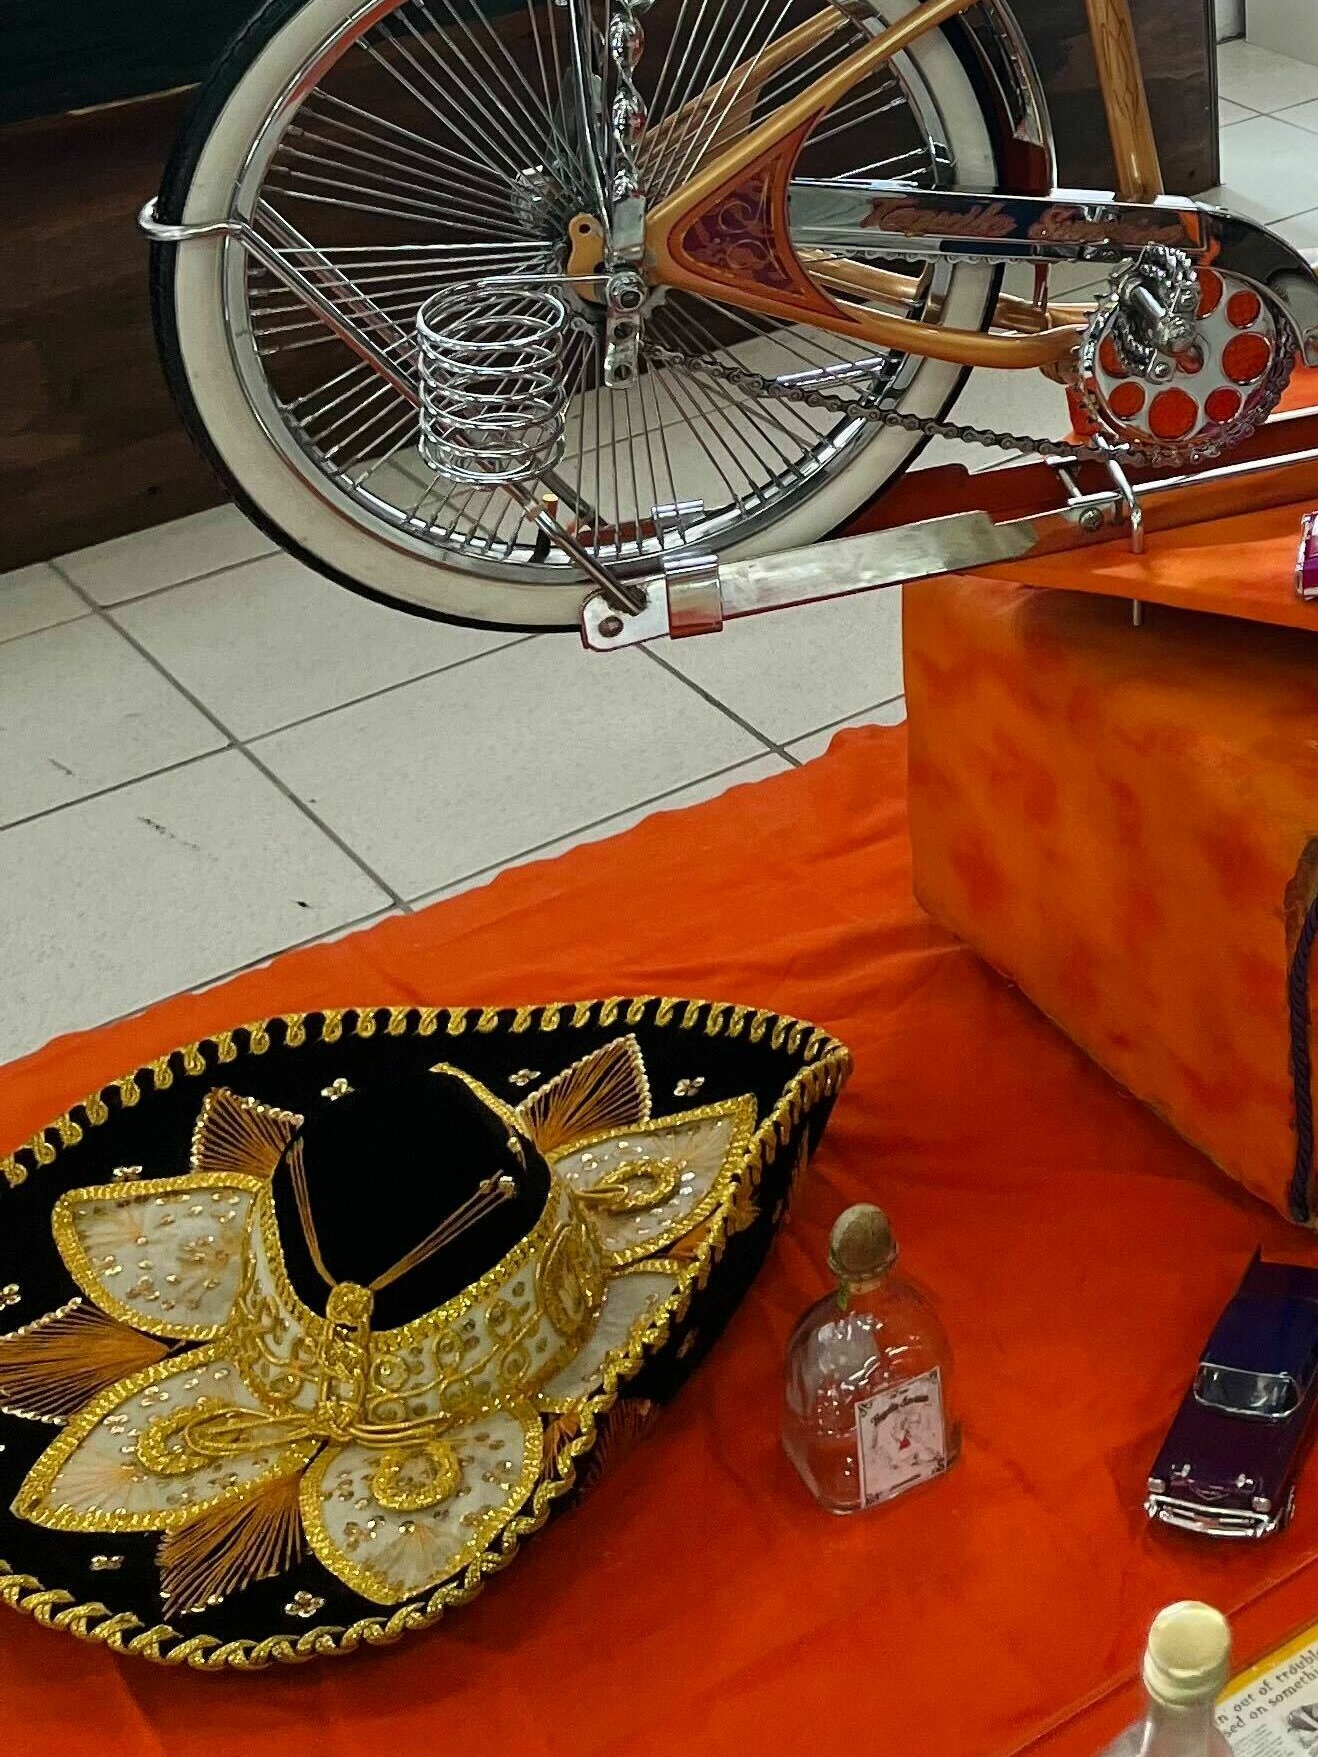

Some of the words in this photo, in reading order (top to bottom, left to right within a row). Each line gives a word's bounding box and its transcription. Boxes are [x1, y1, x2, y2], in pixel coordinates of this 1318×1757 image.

[1233, 1694, 1256, 1712] out
[1259, 1680, 1273, 1696] of
[1250, 1706, 1268, 1720] on
